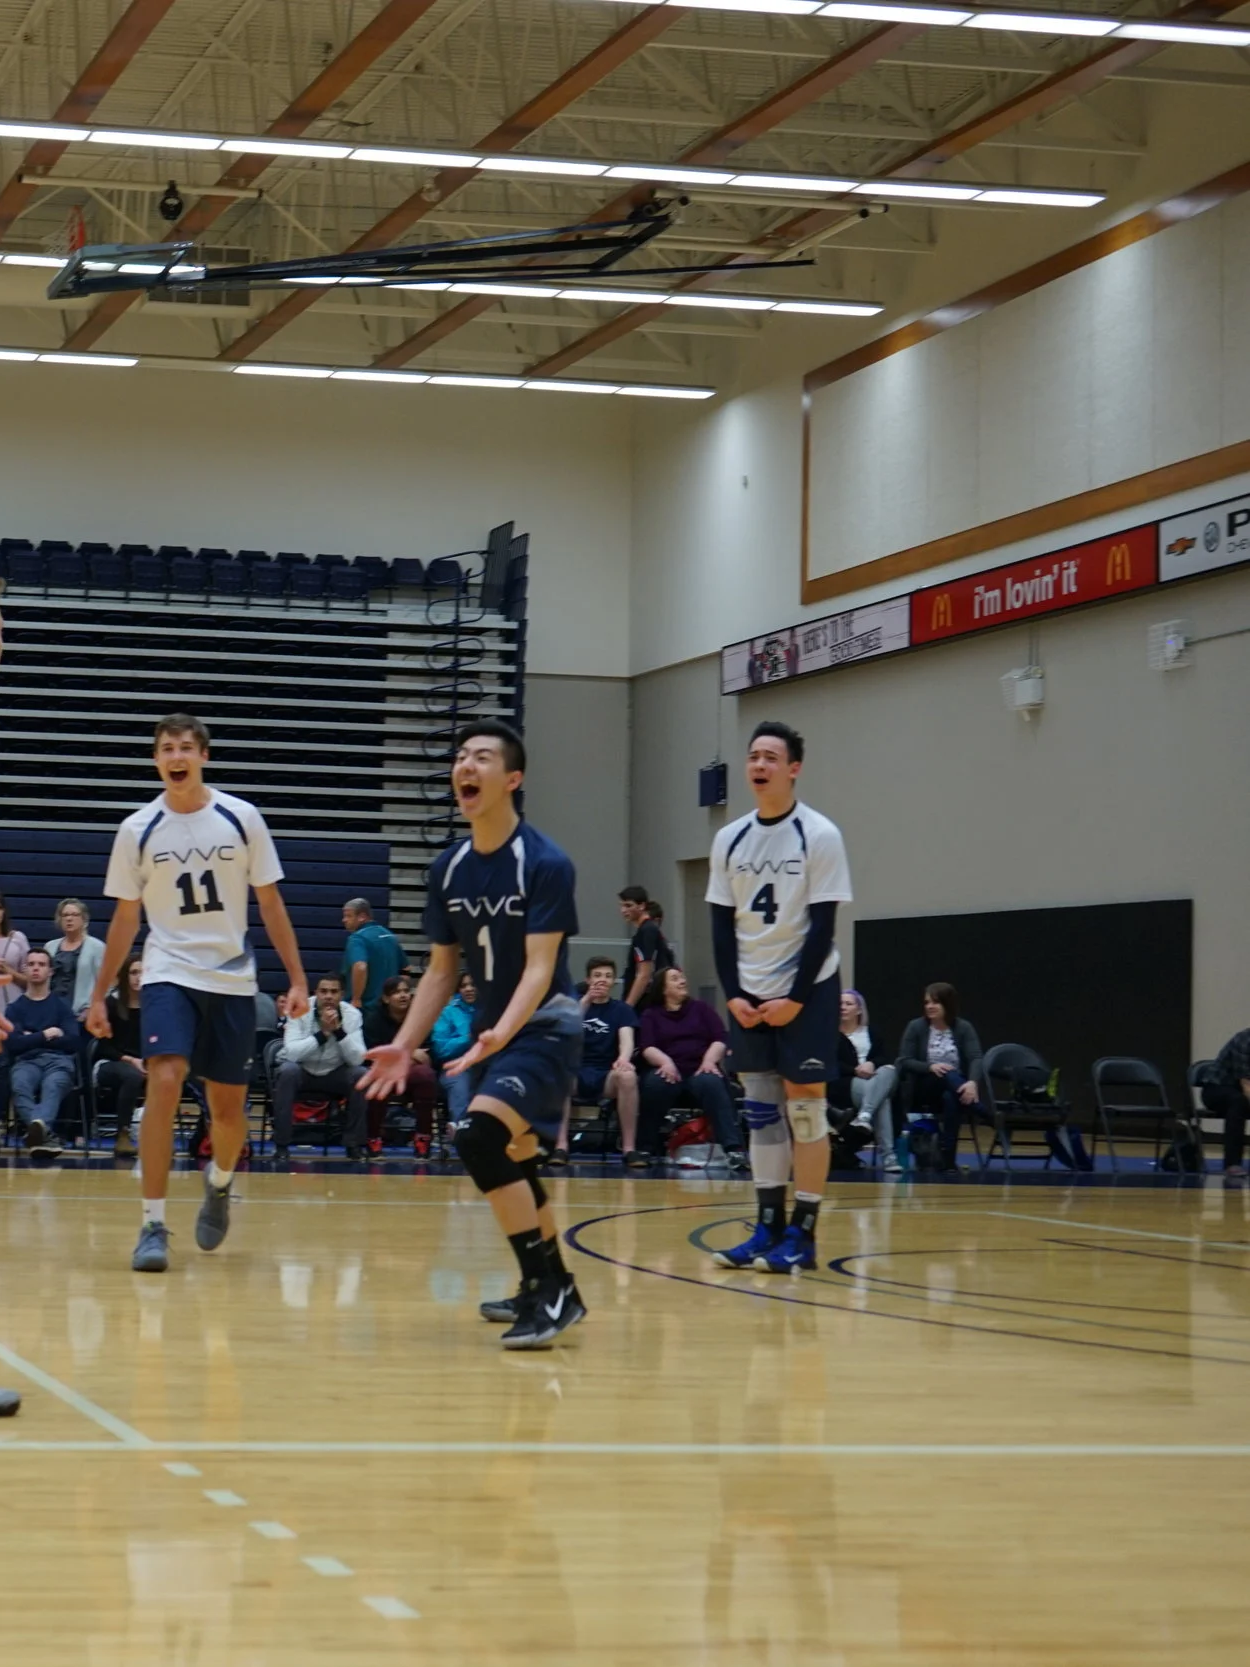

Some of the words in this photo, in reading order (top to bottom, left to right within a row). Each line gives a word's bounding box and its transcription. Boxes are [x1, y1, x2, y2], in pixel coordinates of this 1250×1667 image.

[973, 585, 1002, 619] i'm
[1006, 564, 1059, 610] lovin'
[1062, 560, 1079, 595] it
[176, 869, 225, 916] 11
[751, 882, 779, 925] 4
[477, 925, 494, 981] 1
